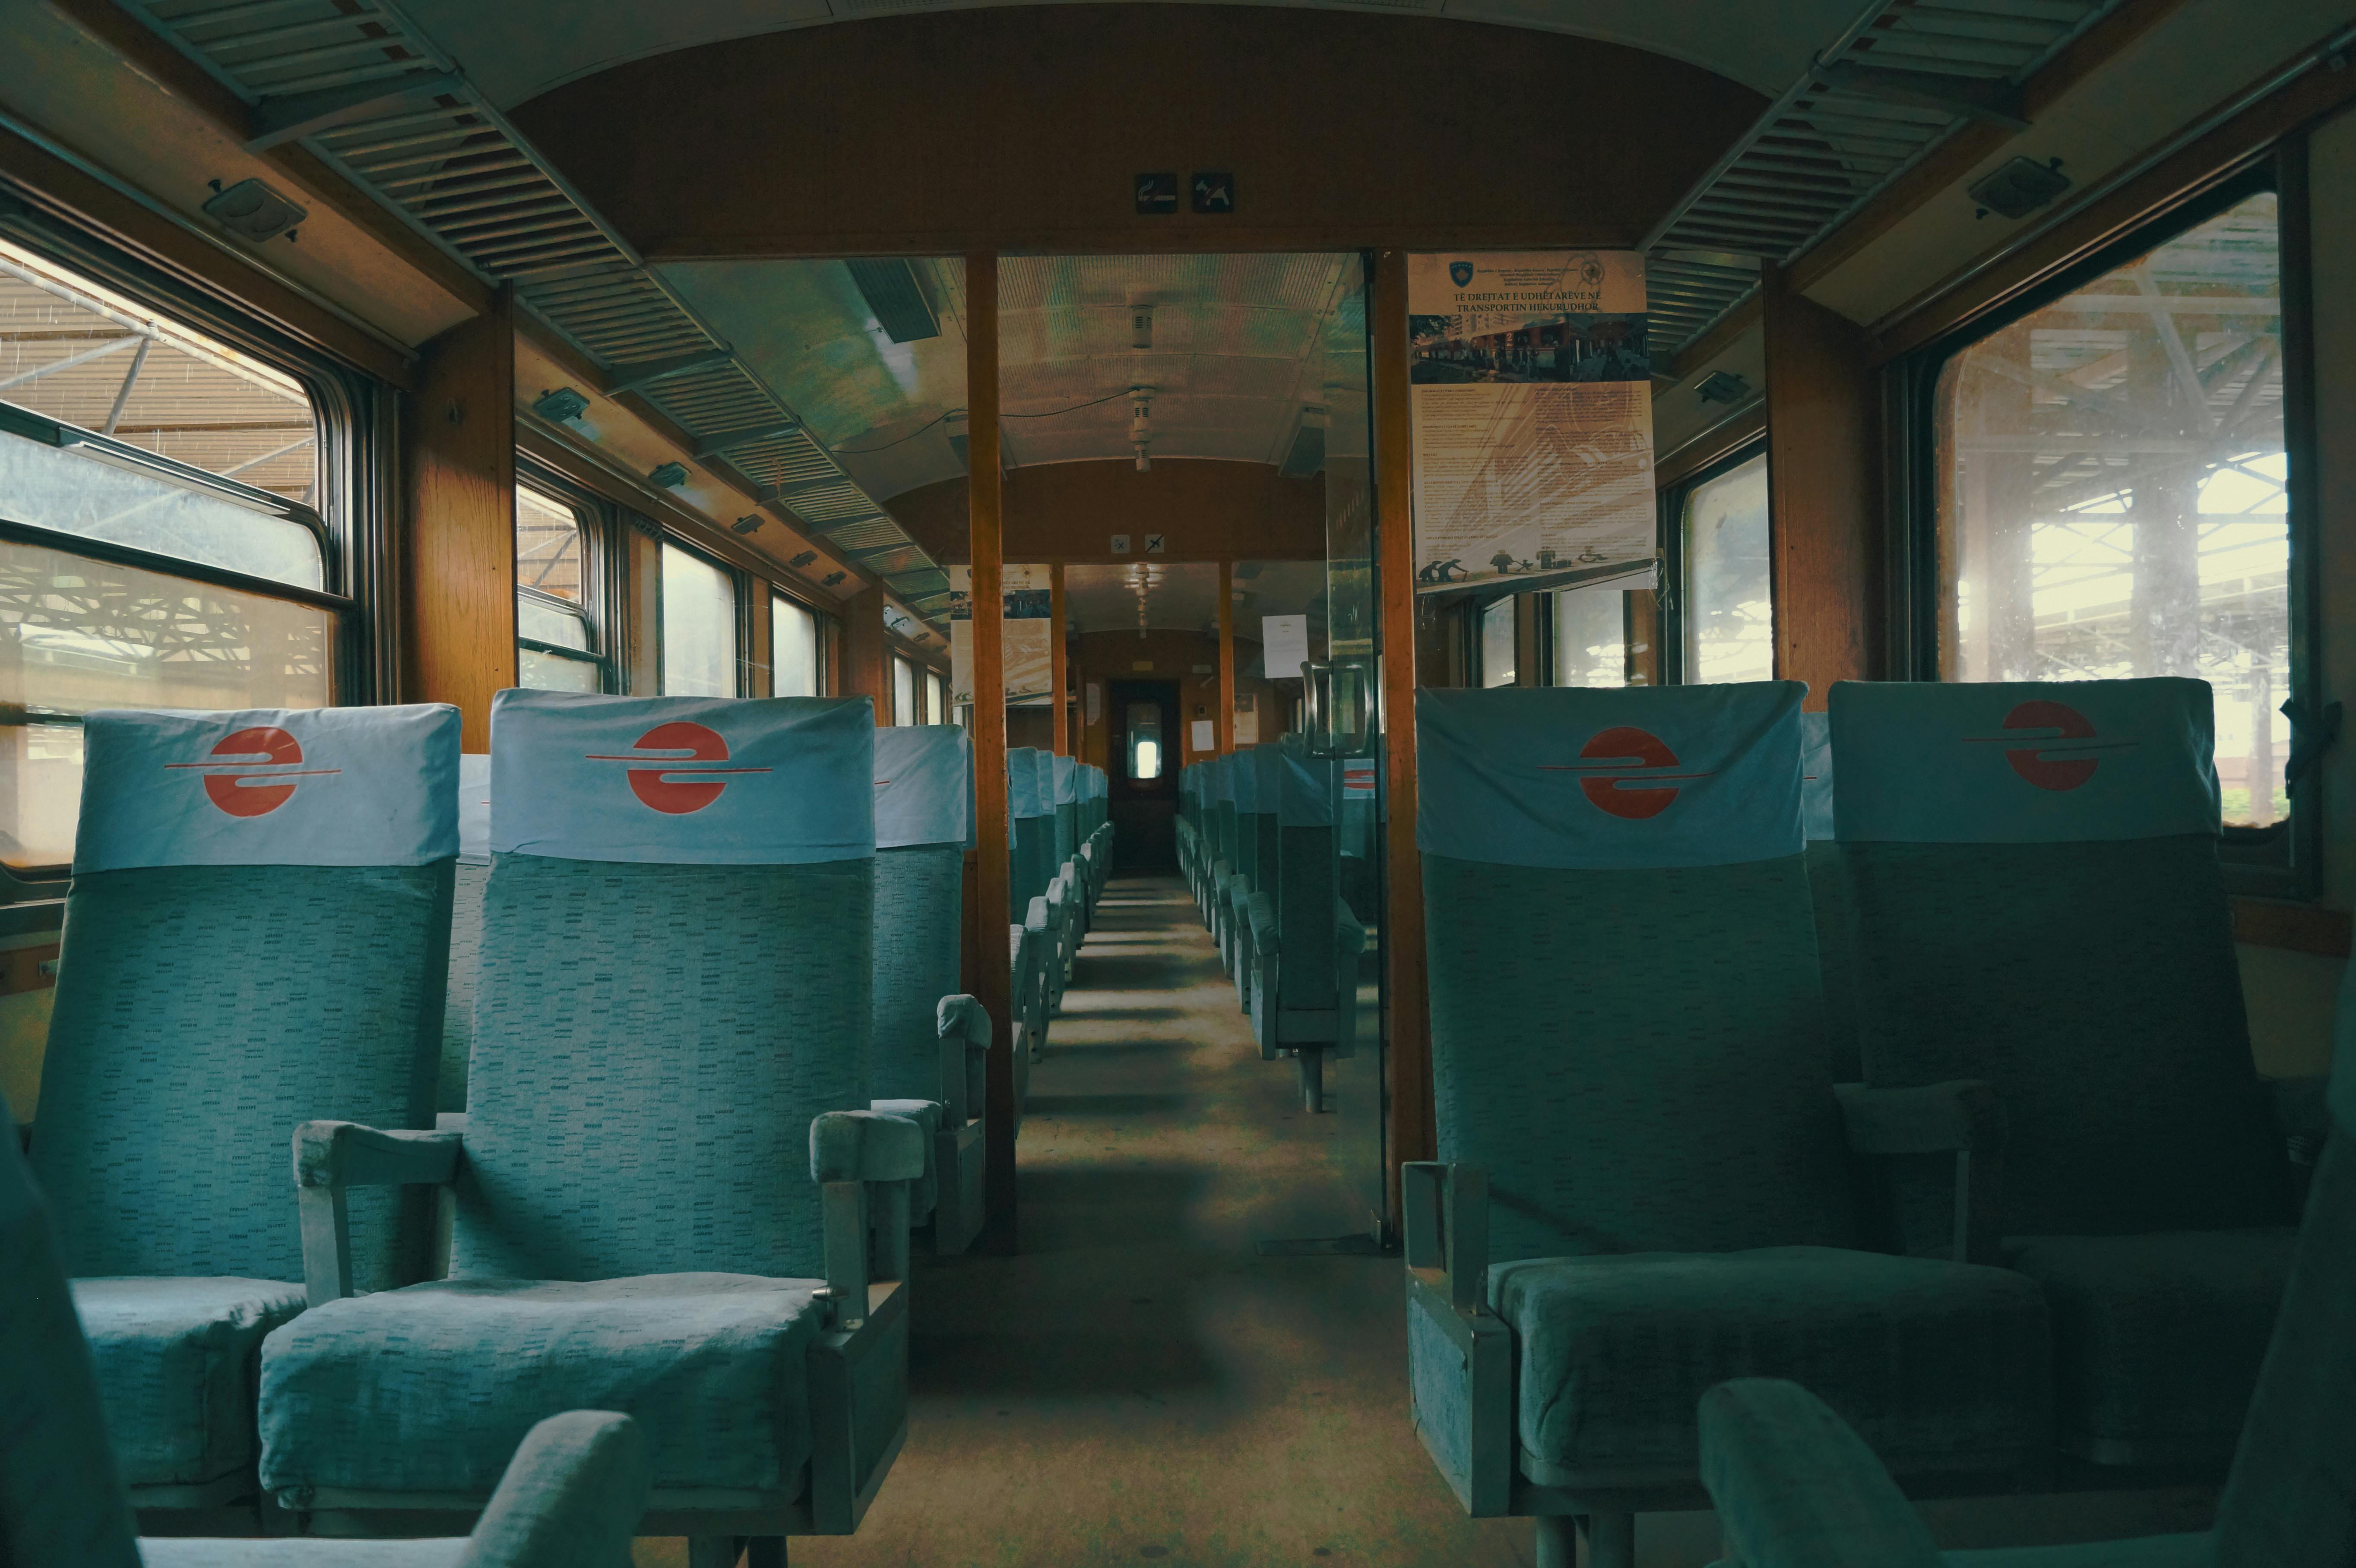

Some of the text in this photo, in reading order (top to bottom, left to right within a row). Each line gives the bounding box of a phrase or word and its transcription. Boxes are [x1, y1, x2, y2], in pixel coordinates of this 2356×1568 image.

[1454, 292, 1465, 301] TË
[1468, 292, 1510, 302] DREJTAT
[1521, 291, 1586, 300] UDHËTARËVE
[1588, 291, 1601, 300] NË
[1457, 303, 1599, 313] TRANSPORTIN HEKURUDHOR
[1507, 332, 1512, 341] 2
